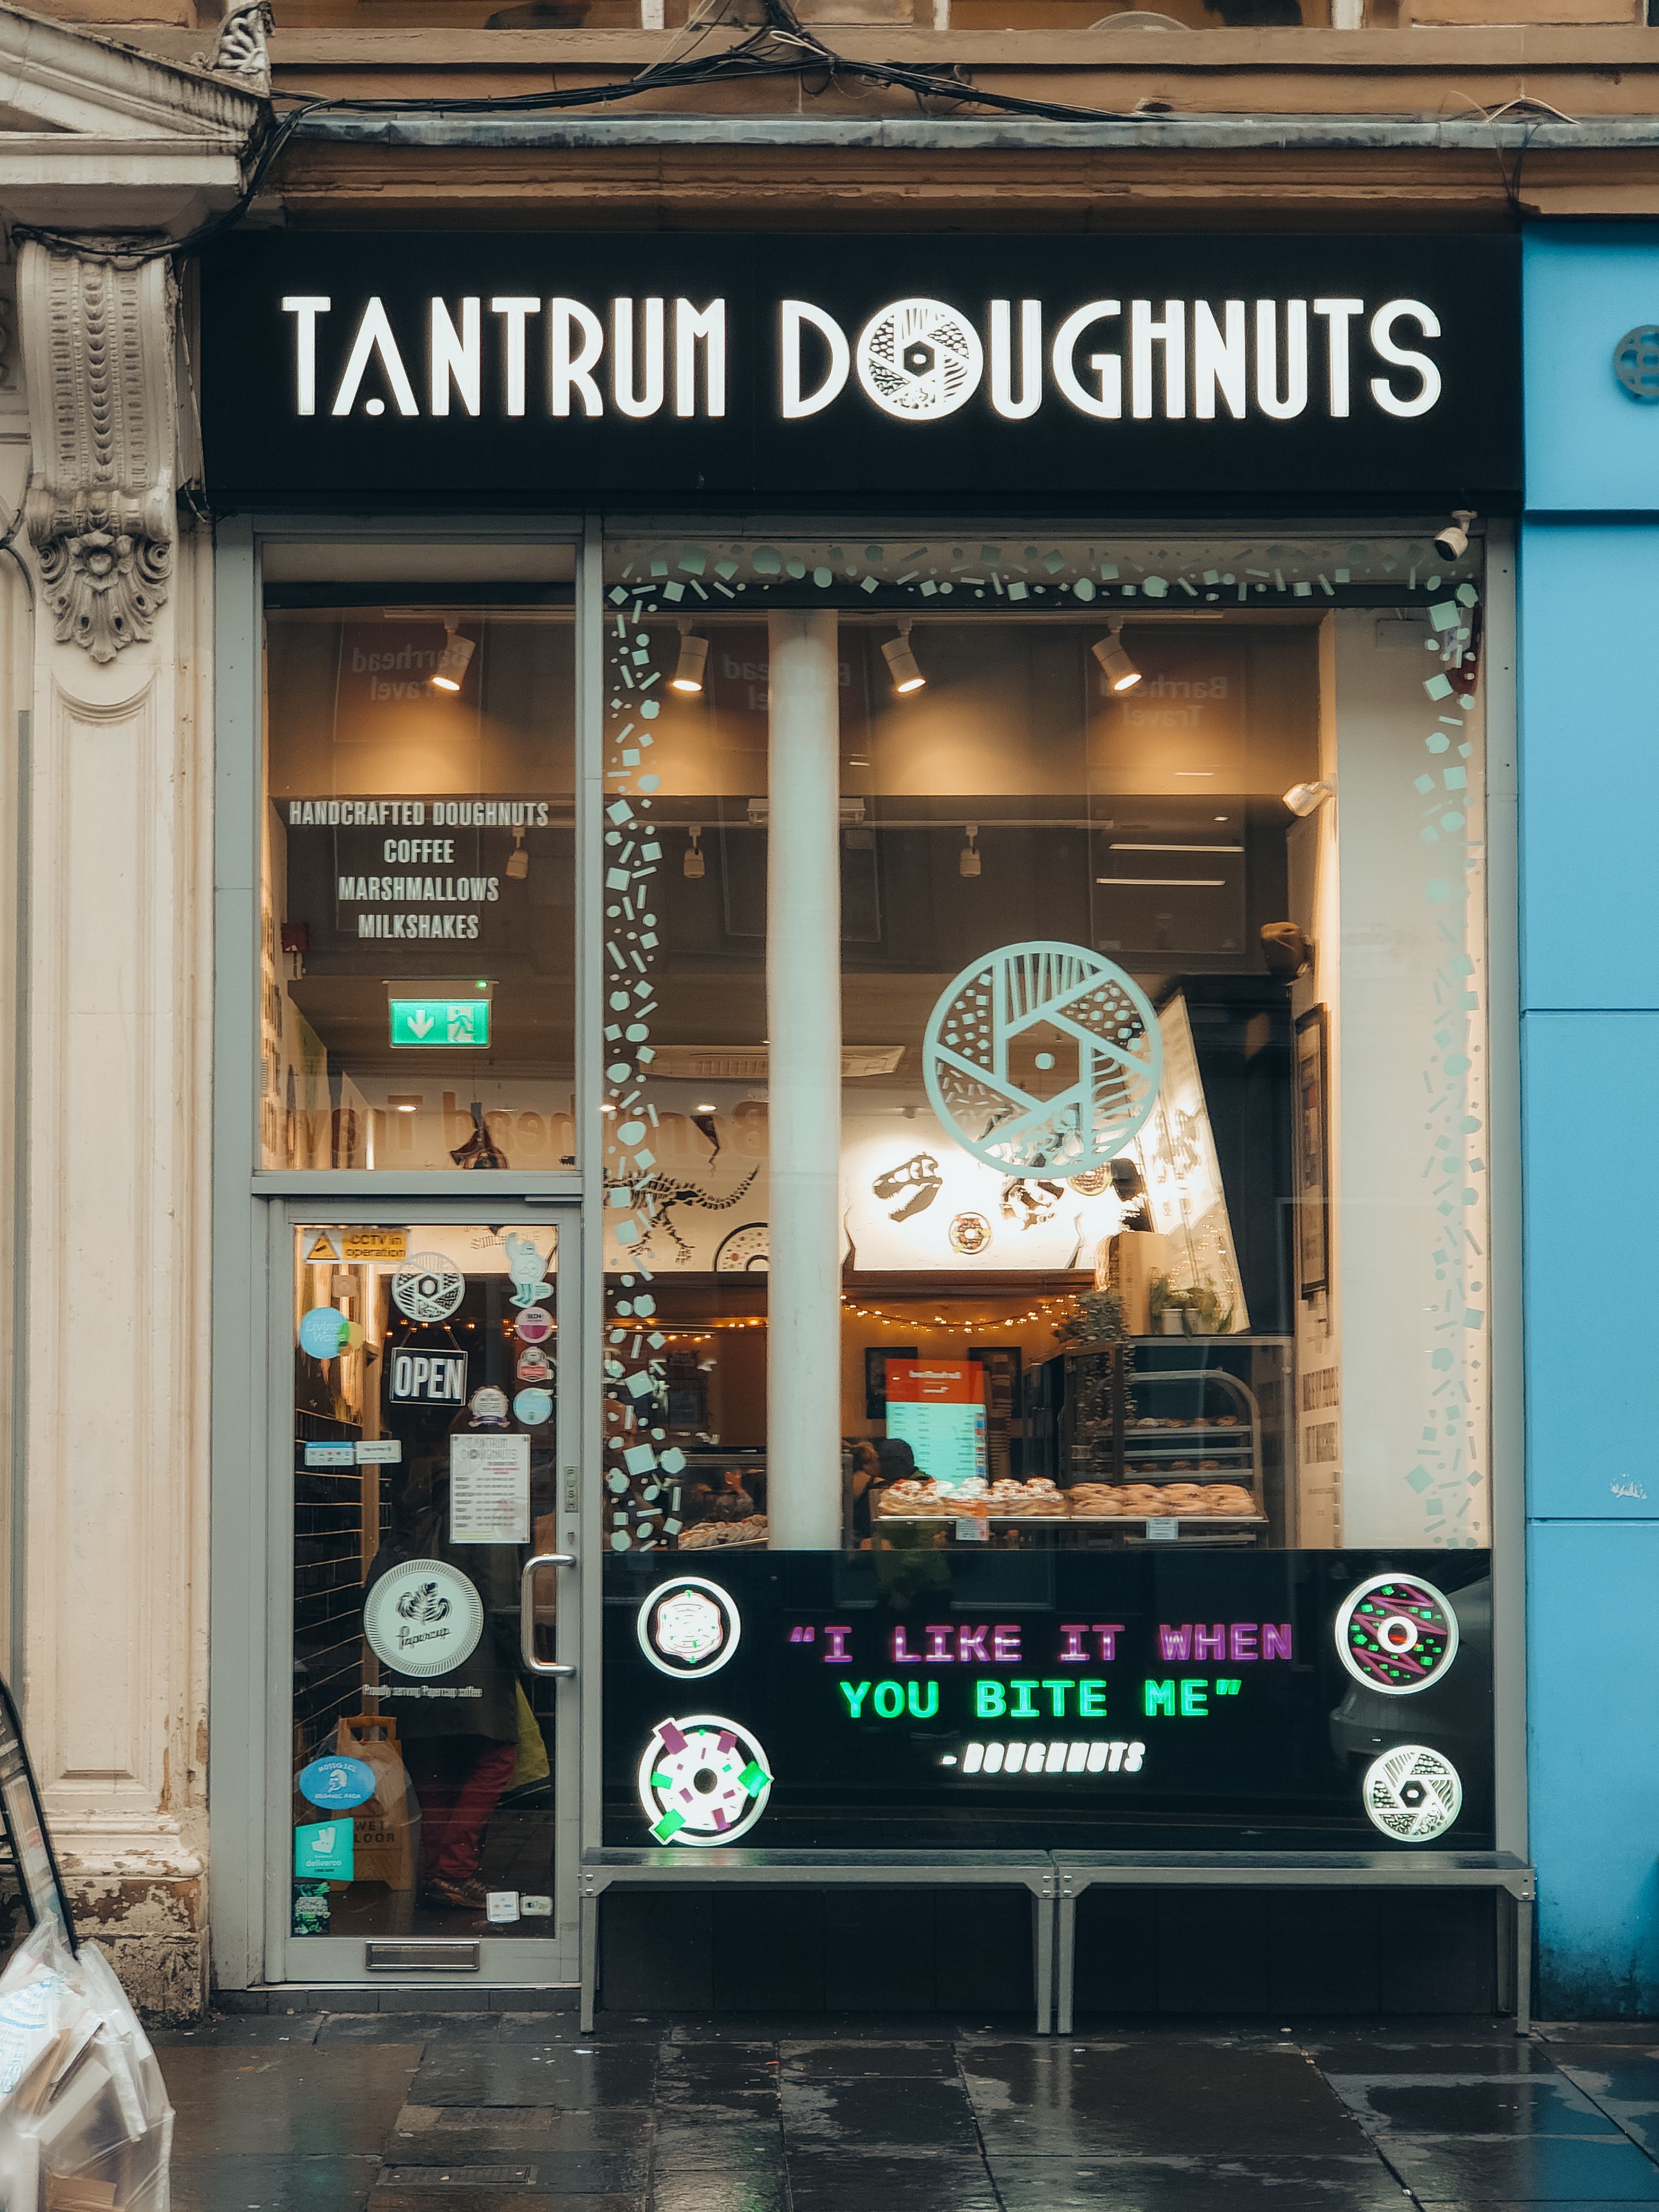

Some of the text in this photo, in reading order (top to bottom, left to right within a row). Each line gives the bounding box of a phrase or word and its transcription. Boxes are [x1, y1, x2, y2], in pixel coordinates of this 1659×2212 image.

[283, 296, 1441, 421] TANTRUM DOUGHNUTS
[290, 801, 549, 826] HANDCRAFTED DOUGHNUTS
[384, 839, 454, 863] COFFEE
[338, 877, 499, 901] MARSHMALLOWS
[358, 915, 479, 939] MILKSHAKES
[351, 1234, 402, 1245] CCTV in
[346, 1248, 406, 1259] operation
[394, 1356, 464, 1400] OPEN
[894, 1624, 1023, 1662] LIKE
[1060, 1624, 1125, 1661] IT
[1159, 1624, 1292, 1661] WHEN
[840, 1680, 939, 1718] YOU
[977, 1680, 1107, 1717] BITE
[354, 1833, 394, 1843] LOOR
